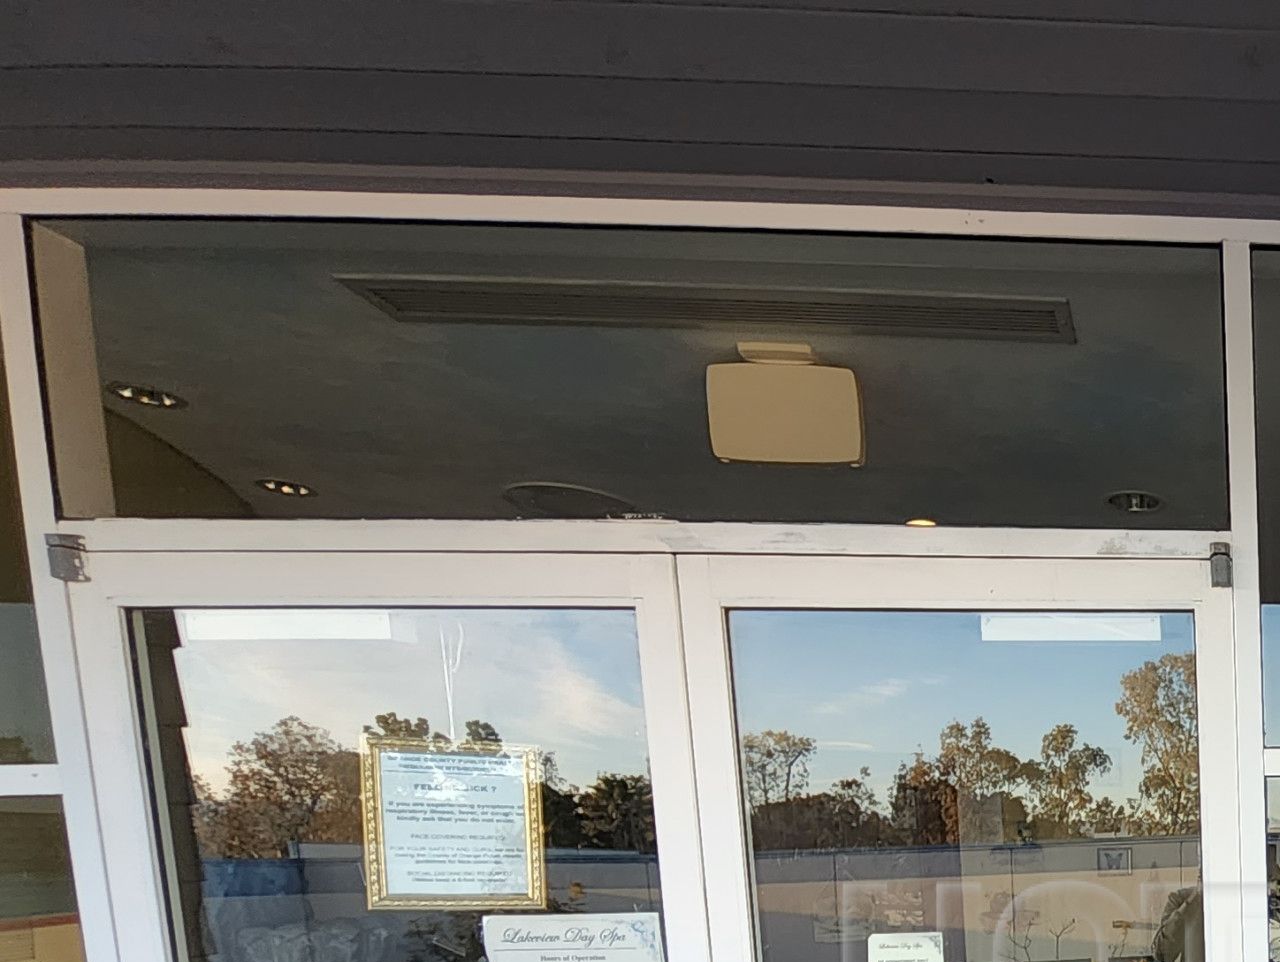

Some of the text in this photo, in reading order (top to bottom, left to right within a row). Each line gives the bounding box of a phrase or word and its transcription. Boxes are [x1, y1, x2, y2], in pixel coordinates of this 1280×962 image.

[501, 927, 626, 948] Lakeview Day Spa
[571, 955, 606, 962] Operation
